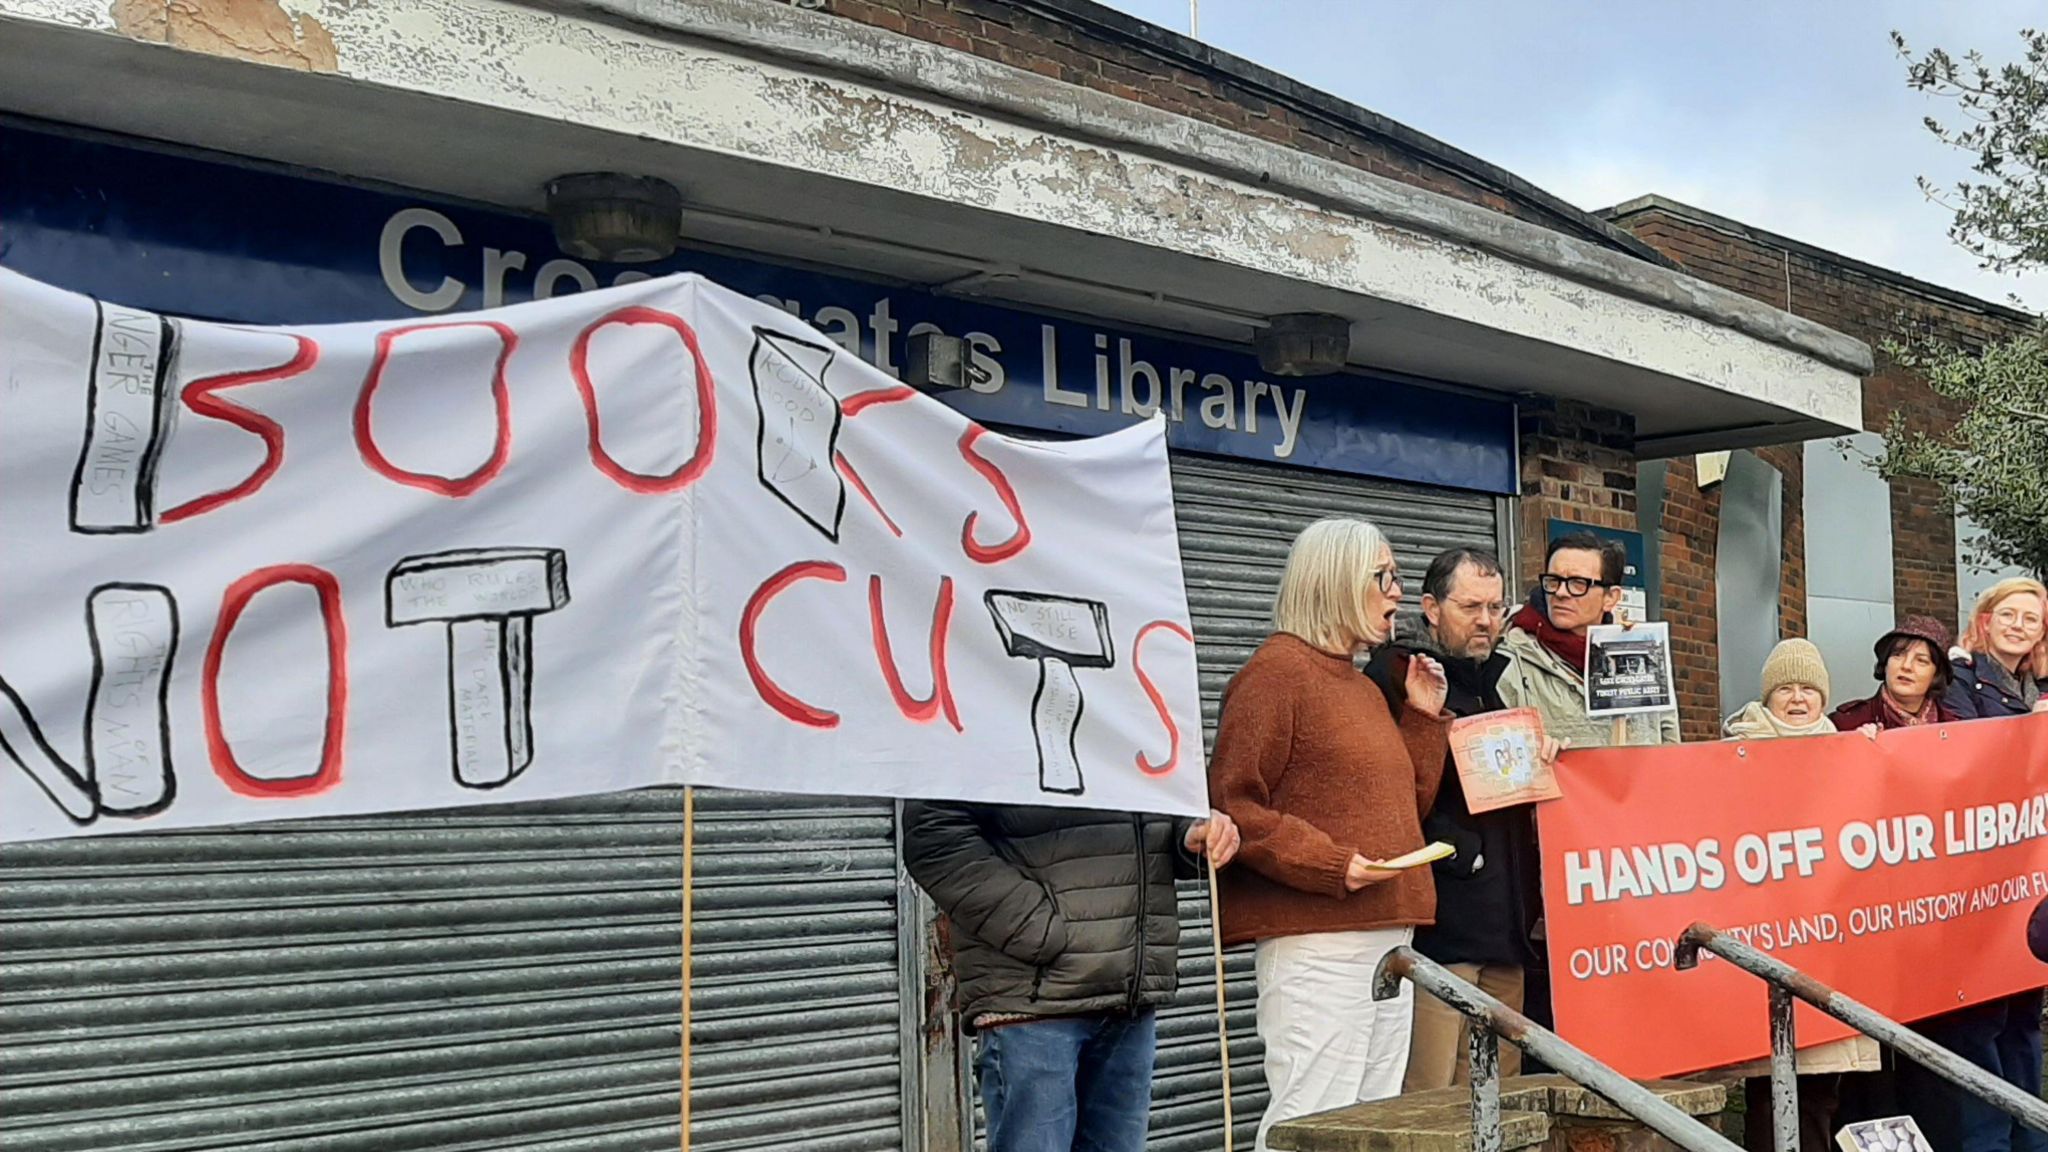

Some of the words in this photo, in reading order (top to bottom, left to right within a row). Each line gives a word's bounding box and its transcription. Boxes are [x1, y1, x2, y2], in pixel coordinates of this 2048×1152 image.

[140, 363, 155, 396] THE
[378, 207, 1005, 393] Croats
[1041, 323, 1306, 458] Library
[70, 296, 1031, 564] BOOKS
[89, 410, 140, 501] GAMES
[739, 560, 1193, 794] CUTS
[99, 717, 142, 795] MAN
[1563, 838, 1726, 906] HANDS
[1733, 826, 1825, 885] OFF
[1838, 813, 1937, 870] OUR
[1569, 942, 1630, 979] OUR
[1775, 913, 1844, 948] LAND,
[1848, 904, 1895, 936] OUR
[1897, 890, 1968, 928] HISTORY
[1969, 882, 1999, 913] AND
[2000, 874, 2031, 904] OUR
